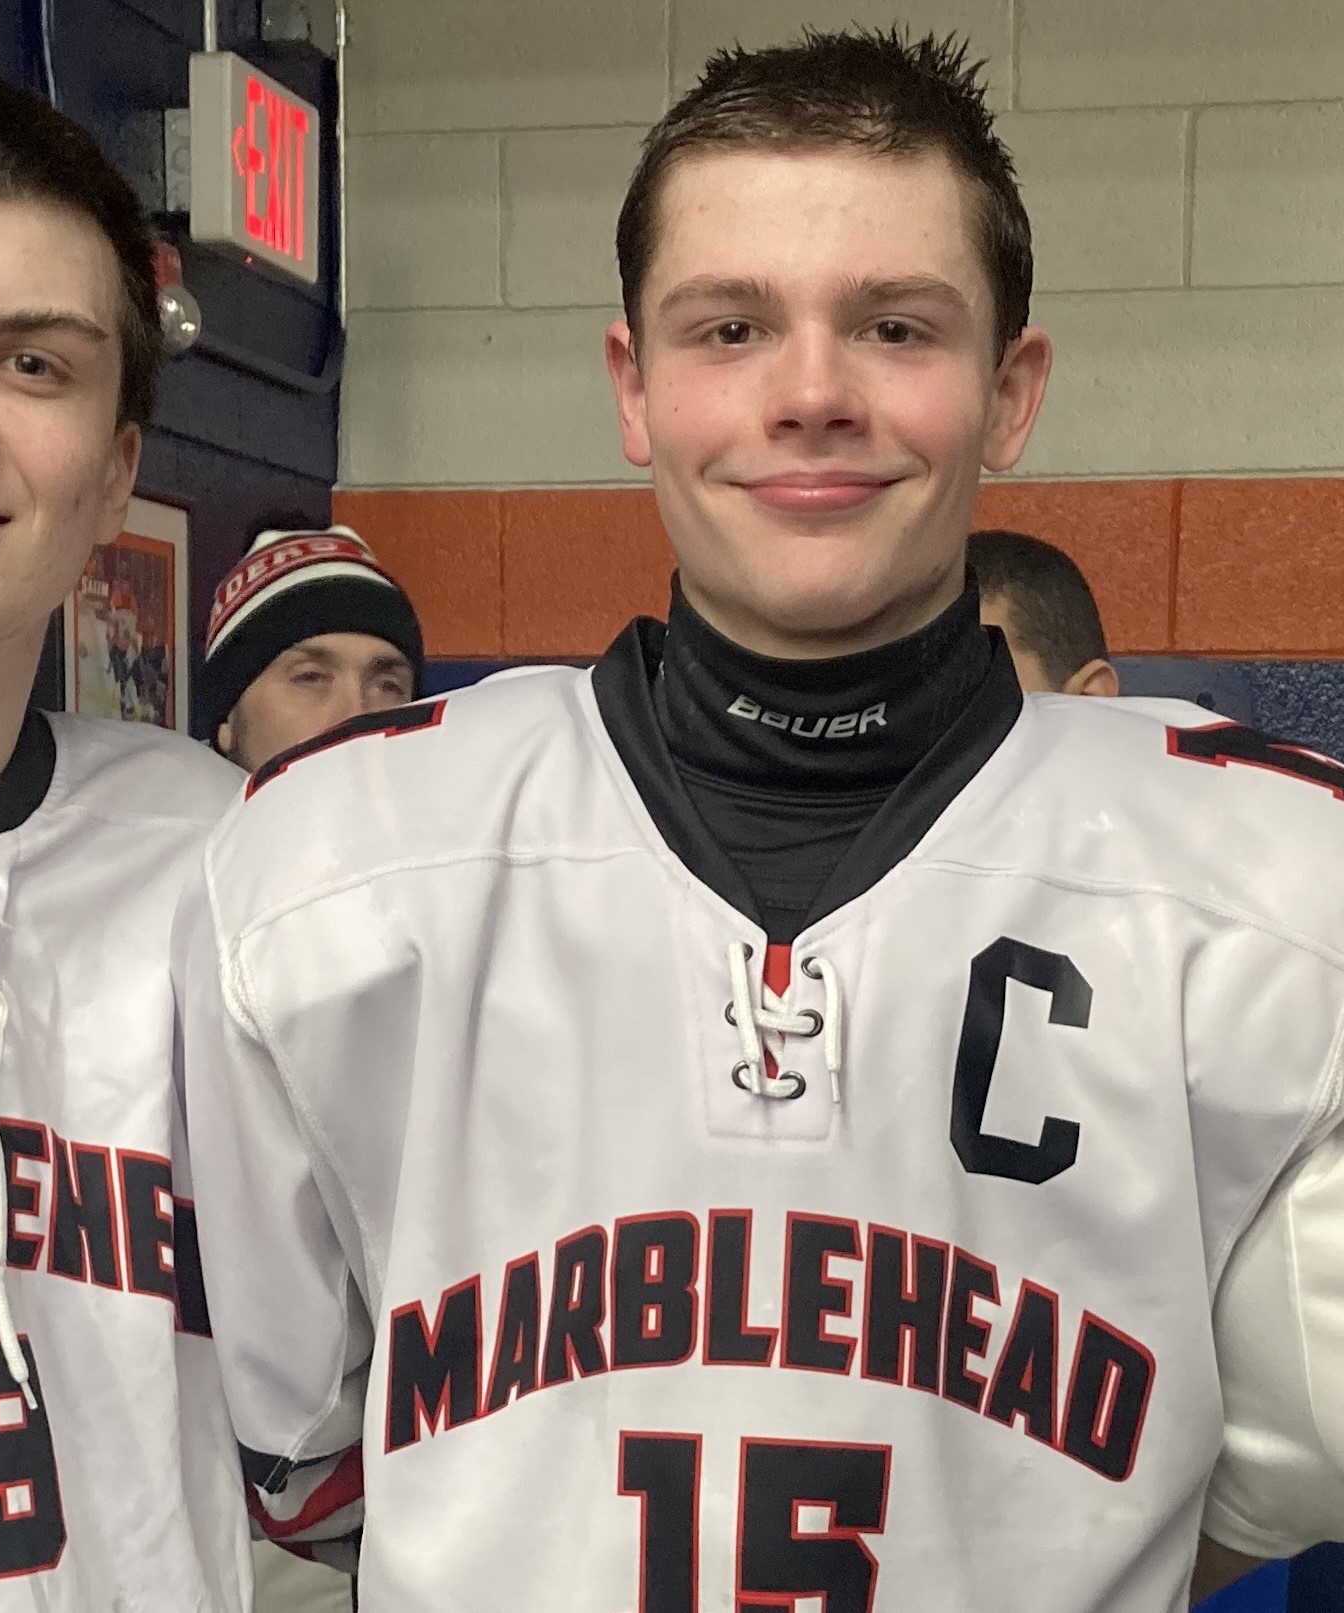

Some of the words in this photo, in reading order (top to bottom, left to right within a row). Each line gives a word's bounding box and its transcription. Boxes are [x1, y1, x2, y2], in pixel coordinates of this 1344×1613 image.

[245, 76, 309, 261] EXIT
[950, 936, 1092, 1185] C
[385, 1209, 1156, 1482] MARBLEHEAD
[617, 1430, 893, 1613] 15
